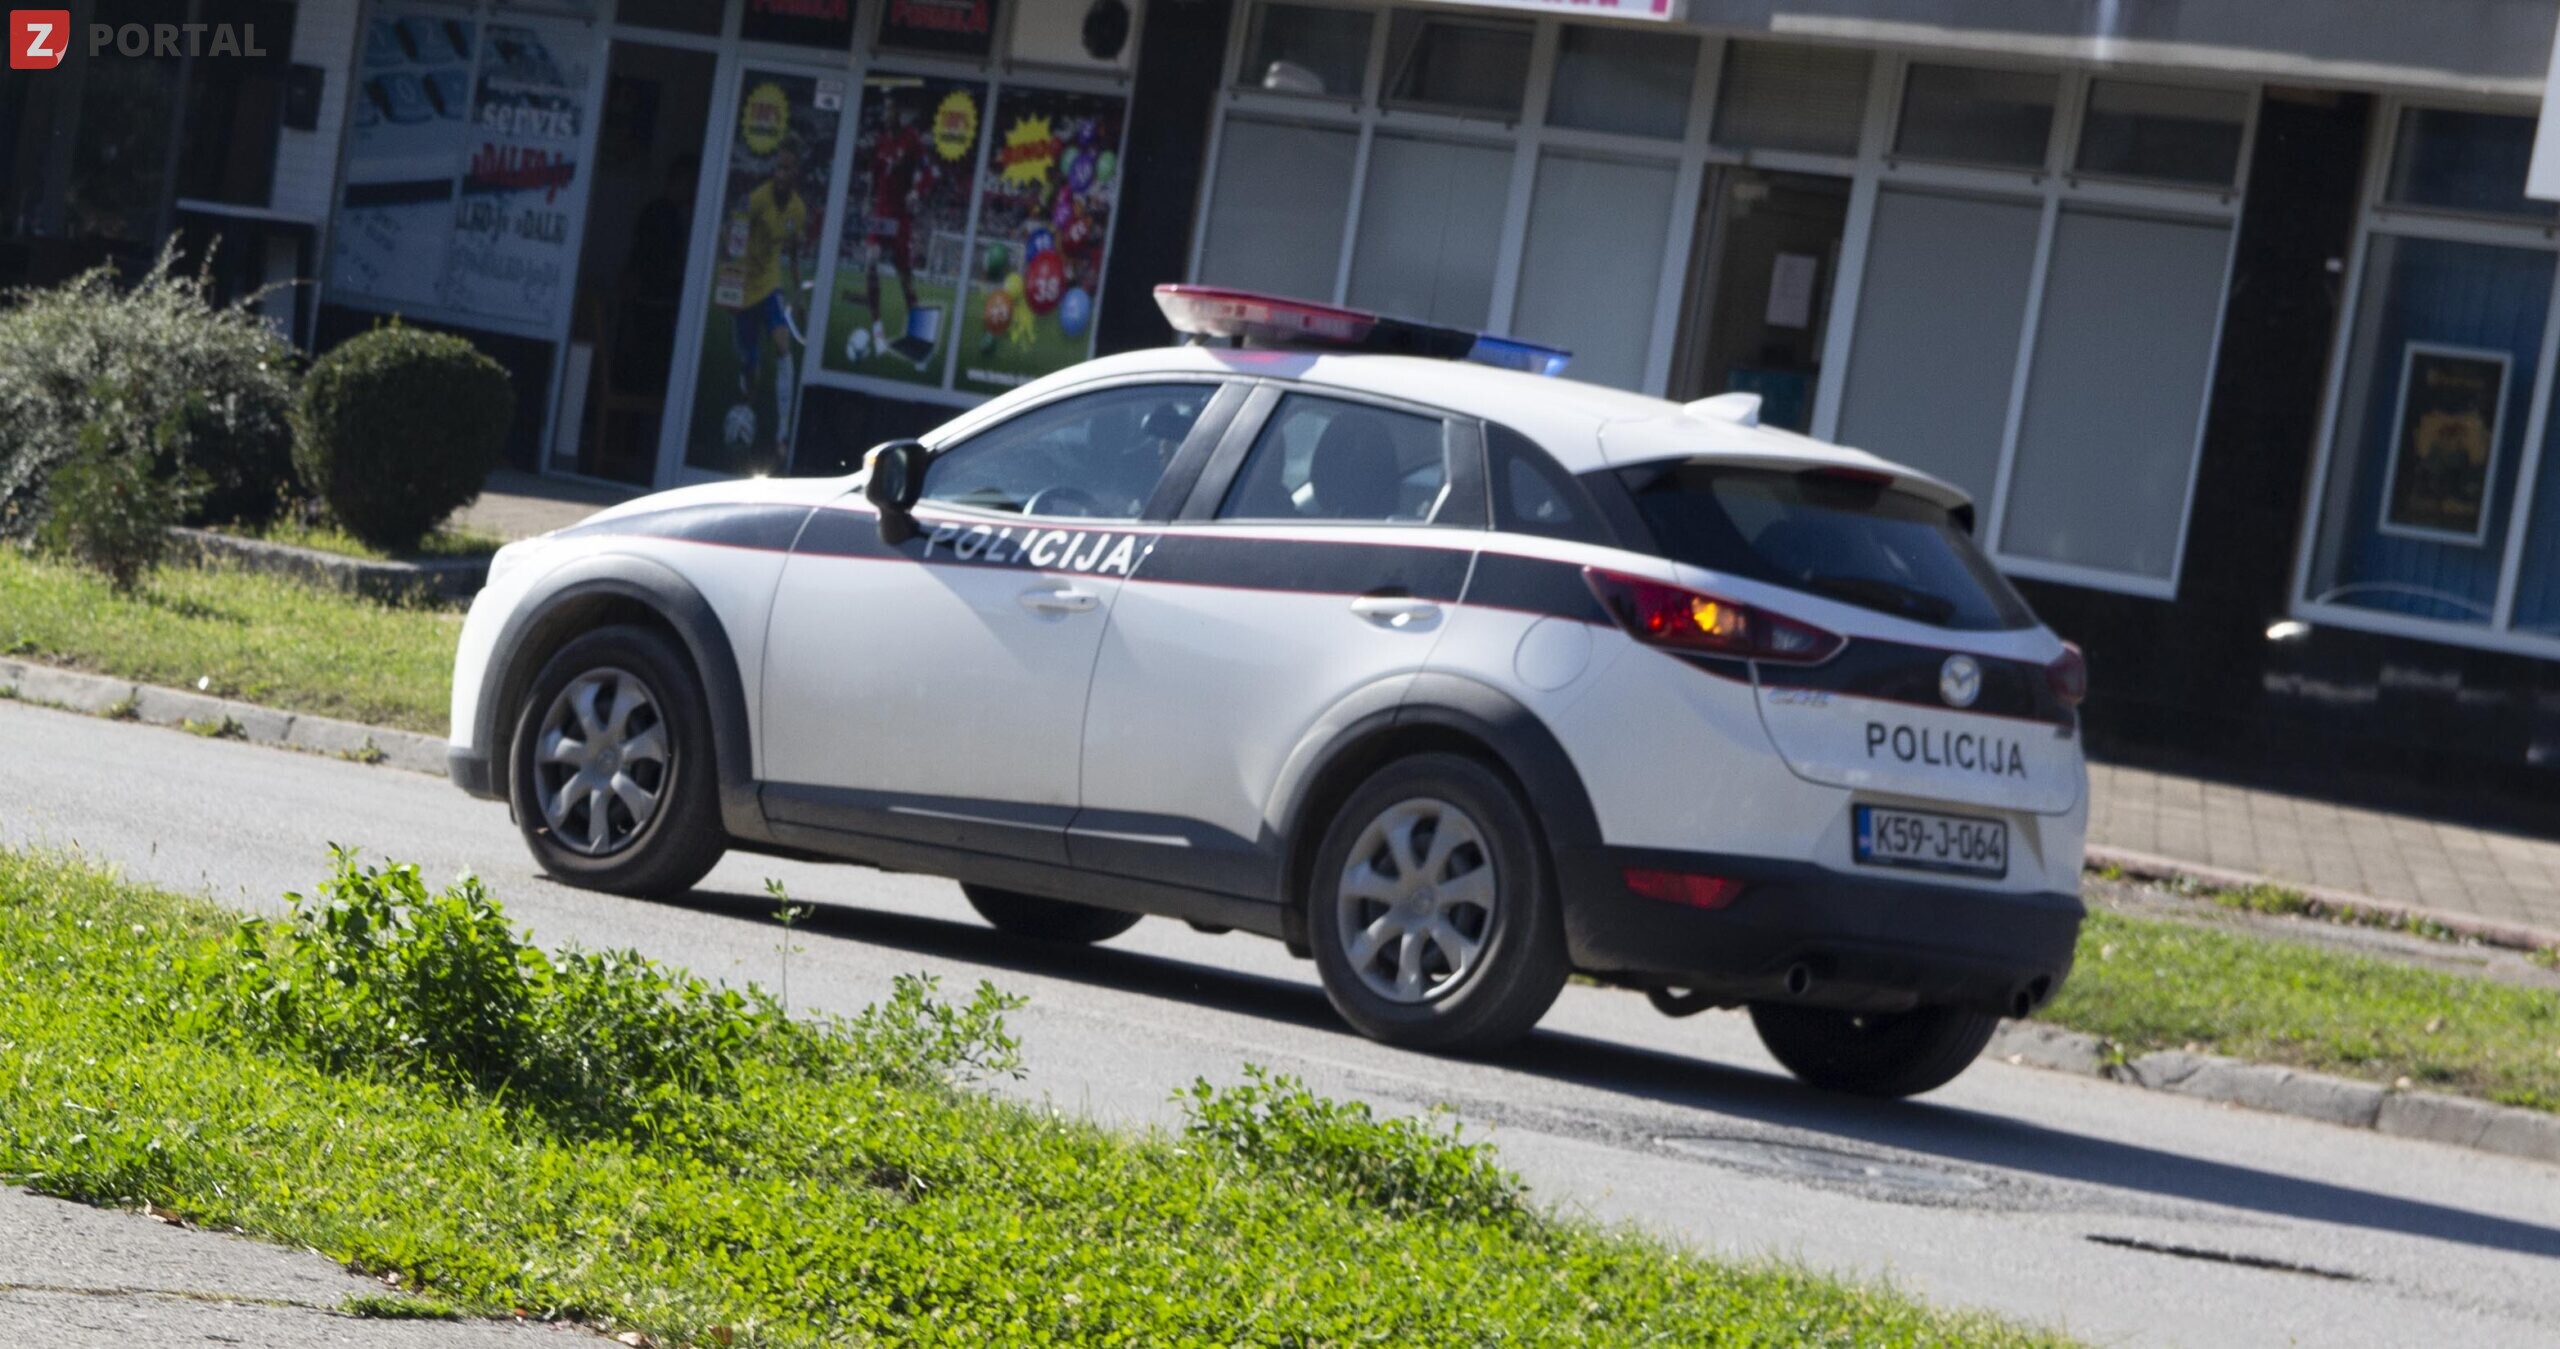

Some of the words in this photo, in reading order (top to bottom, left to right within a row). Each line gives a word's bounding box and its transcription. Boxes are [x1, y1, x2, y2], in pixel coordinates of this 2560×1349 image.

[482, 100, 574, 138] servis
[923, 522, 1137, 576] POLICIJA
[1866, 721, 2026, 778] POLICIJA
[1875, 814, 2002, 863] K59-J-064
